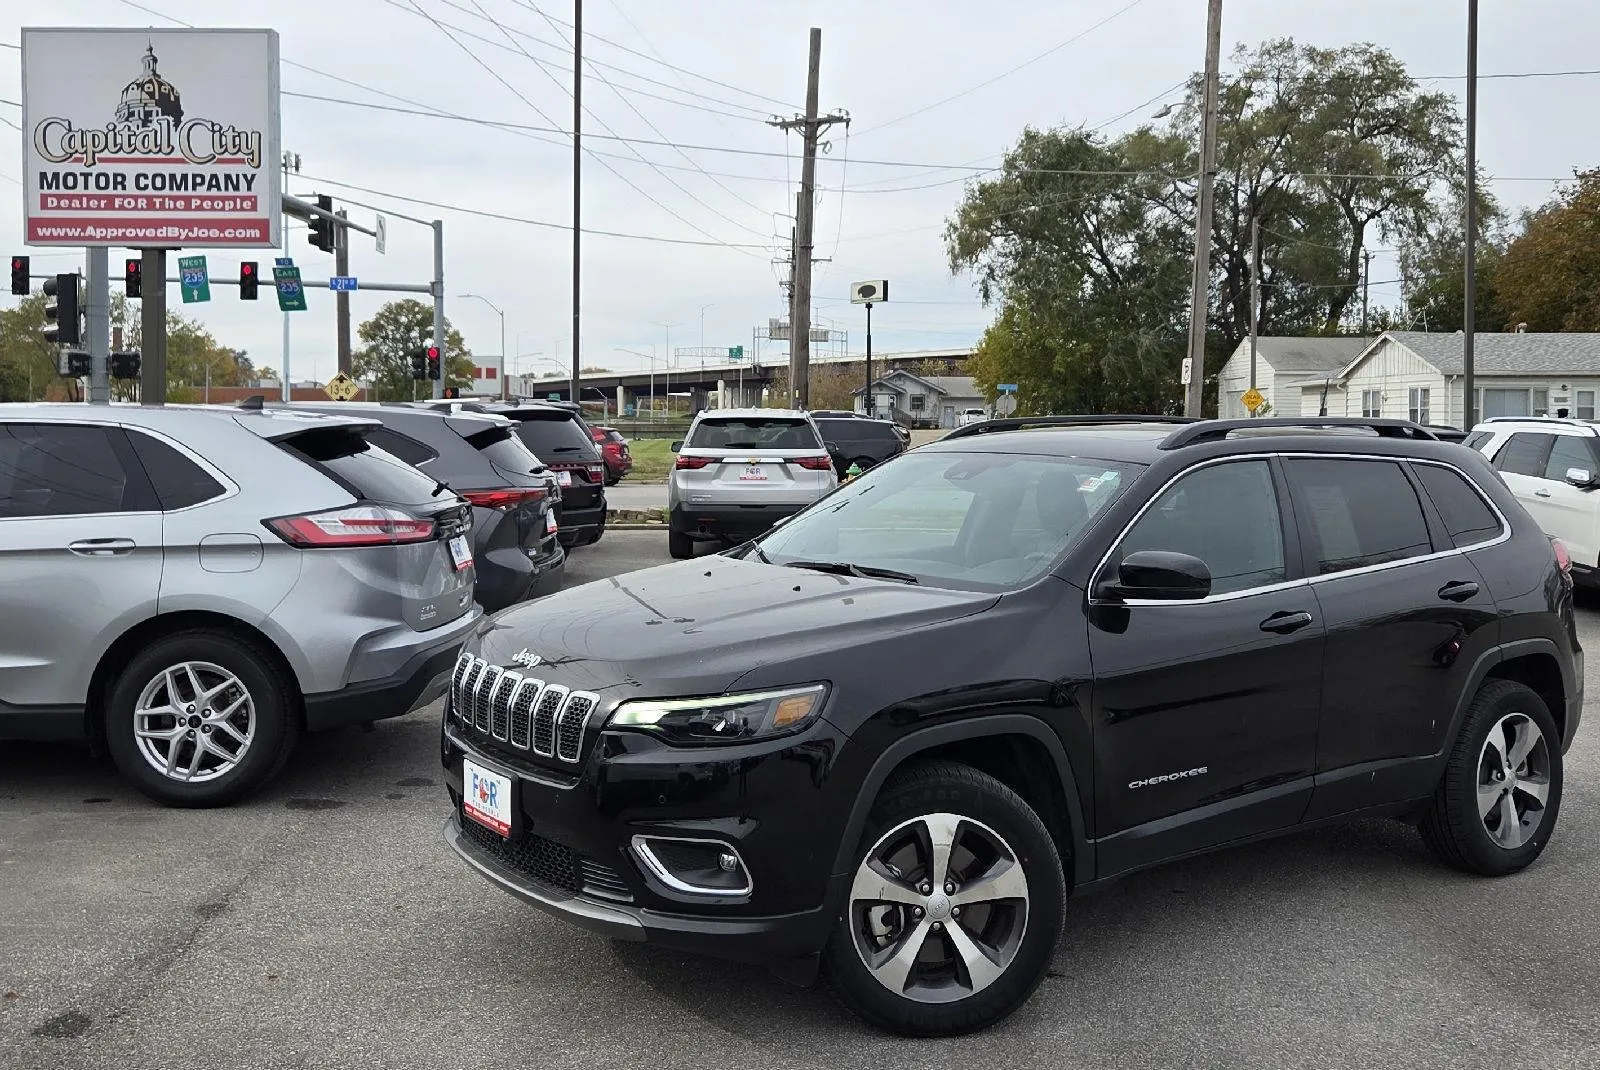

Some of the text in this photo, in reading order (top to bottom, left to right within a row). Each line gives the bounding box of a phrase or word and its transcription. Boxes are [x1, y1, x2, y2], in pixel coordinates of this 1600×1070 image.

[34, 117, 261, 169] Capital City
[39, 172, 257, 192] MOTOR COMPANY
[47, 197, 252, 211] Dealer FOR The People
[37, 225, 260, 240] www.ApprovedByJoe.com
[184, 273, 203, 283] 235
[280, 283, 299, 293] 235
[512, 647, 542, 670] Jeep
[1128, 766, 1208, 789] CHEROKEE
